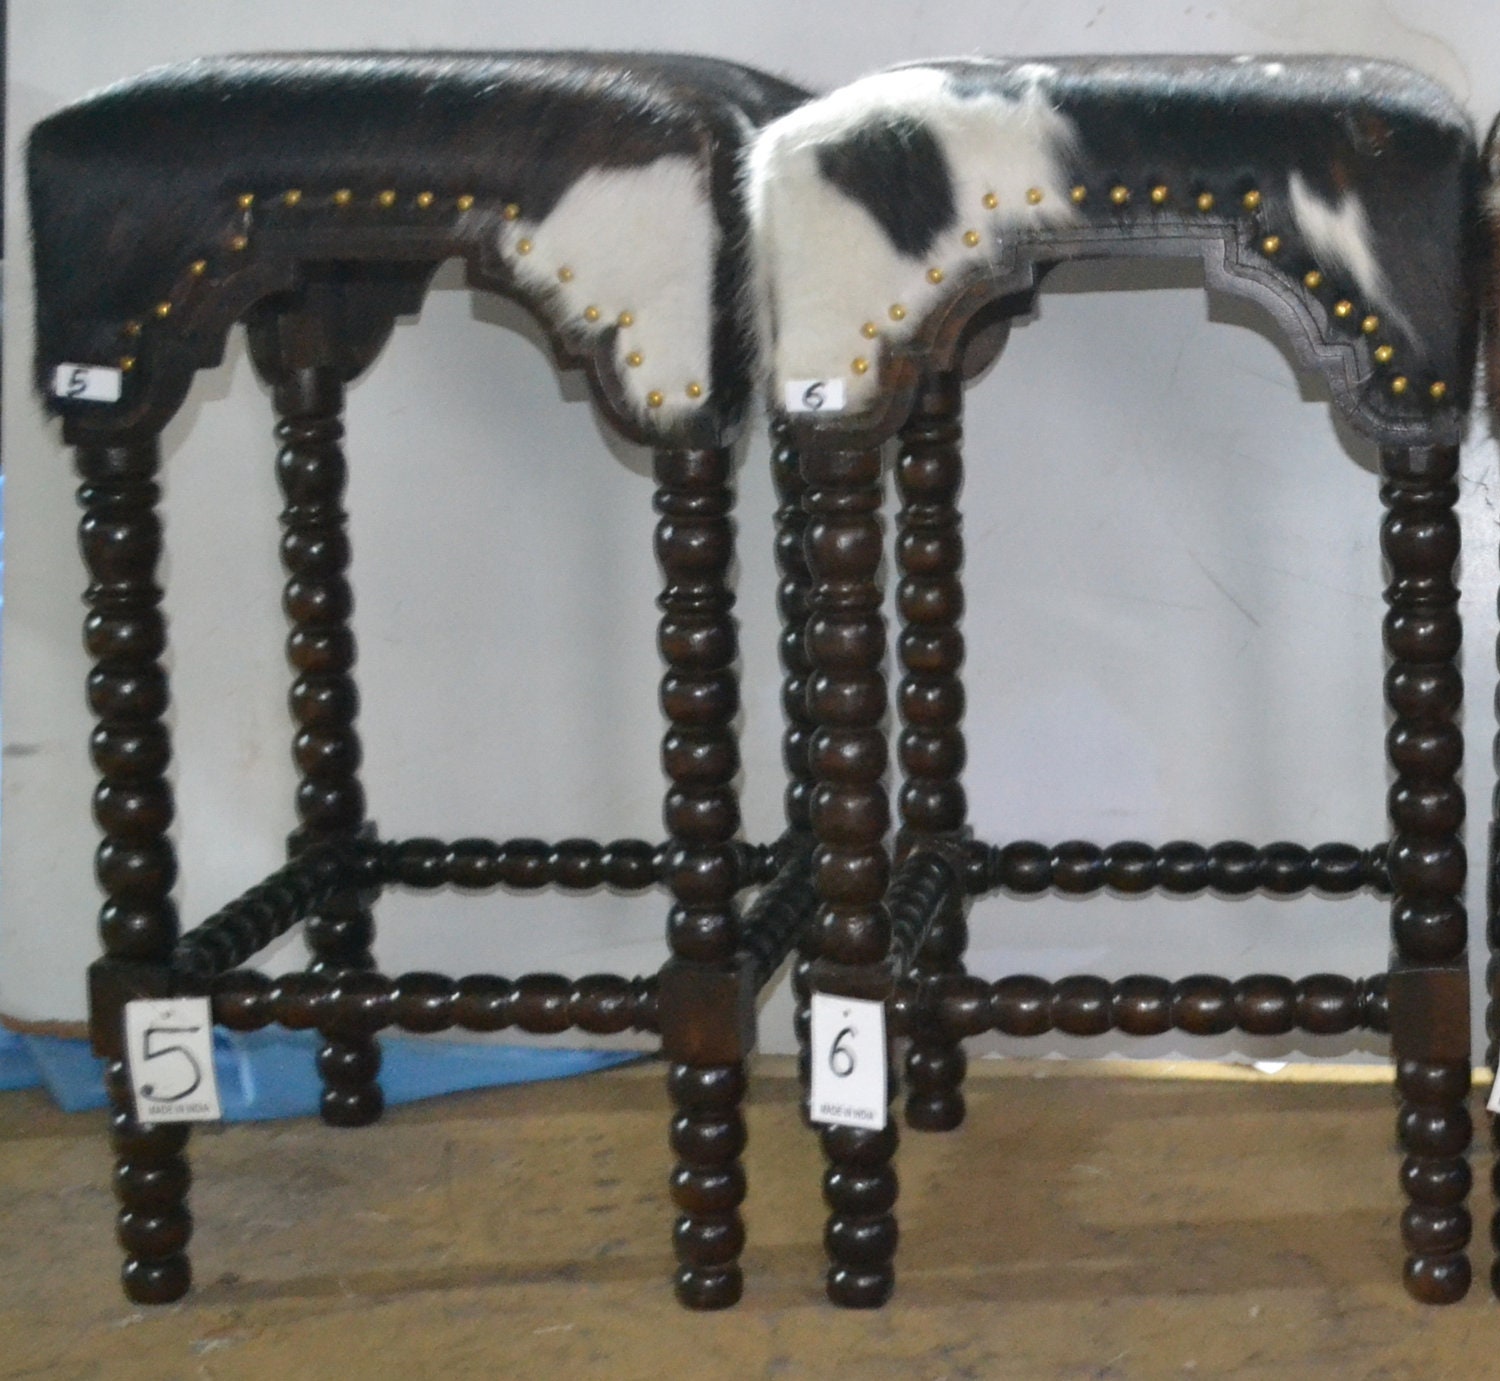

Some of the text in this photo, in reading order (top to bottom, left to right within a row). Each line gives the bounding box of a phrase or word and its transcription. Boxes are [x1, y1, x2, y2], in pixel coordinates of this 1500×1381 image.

[66, 368, 88, 397] 5
[801, 382, 825, 410] 6
[140, 1026, 201, 1102] 5
[829, 1027, 855, 1078] 6
[149, 1102, 210, 1114] MADE IN INDIA
[820, 1104, 874, 1121] MADE IN INDIA
